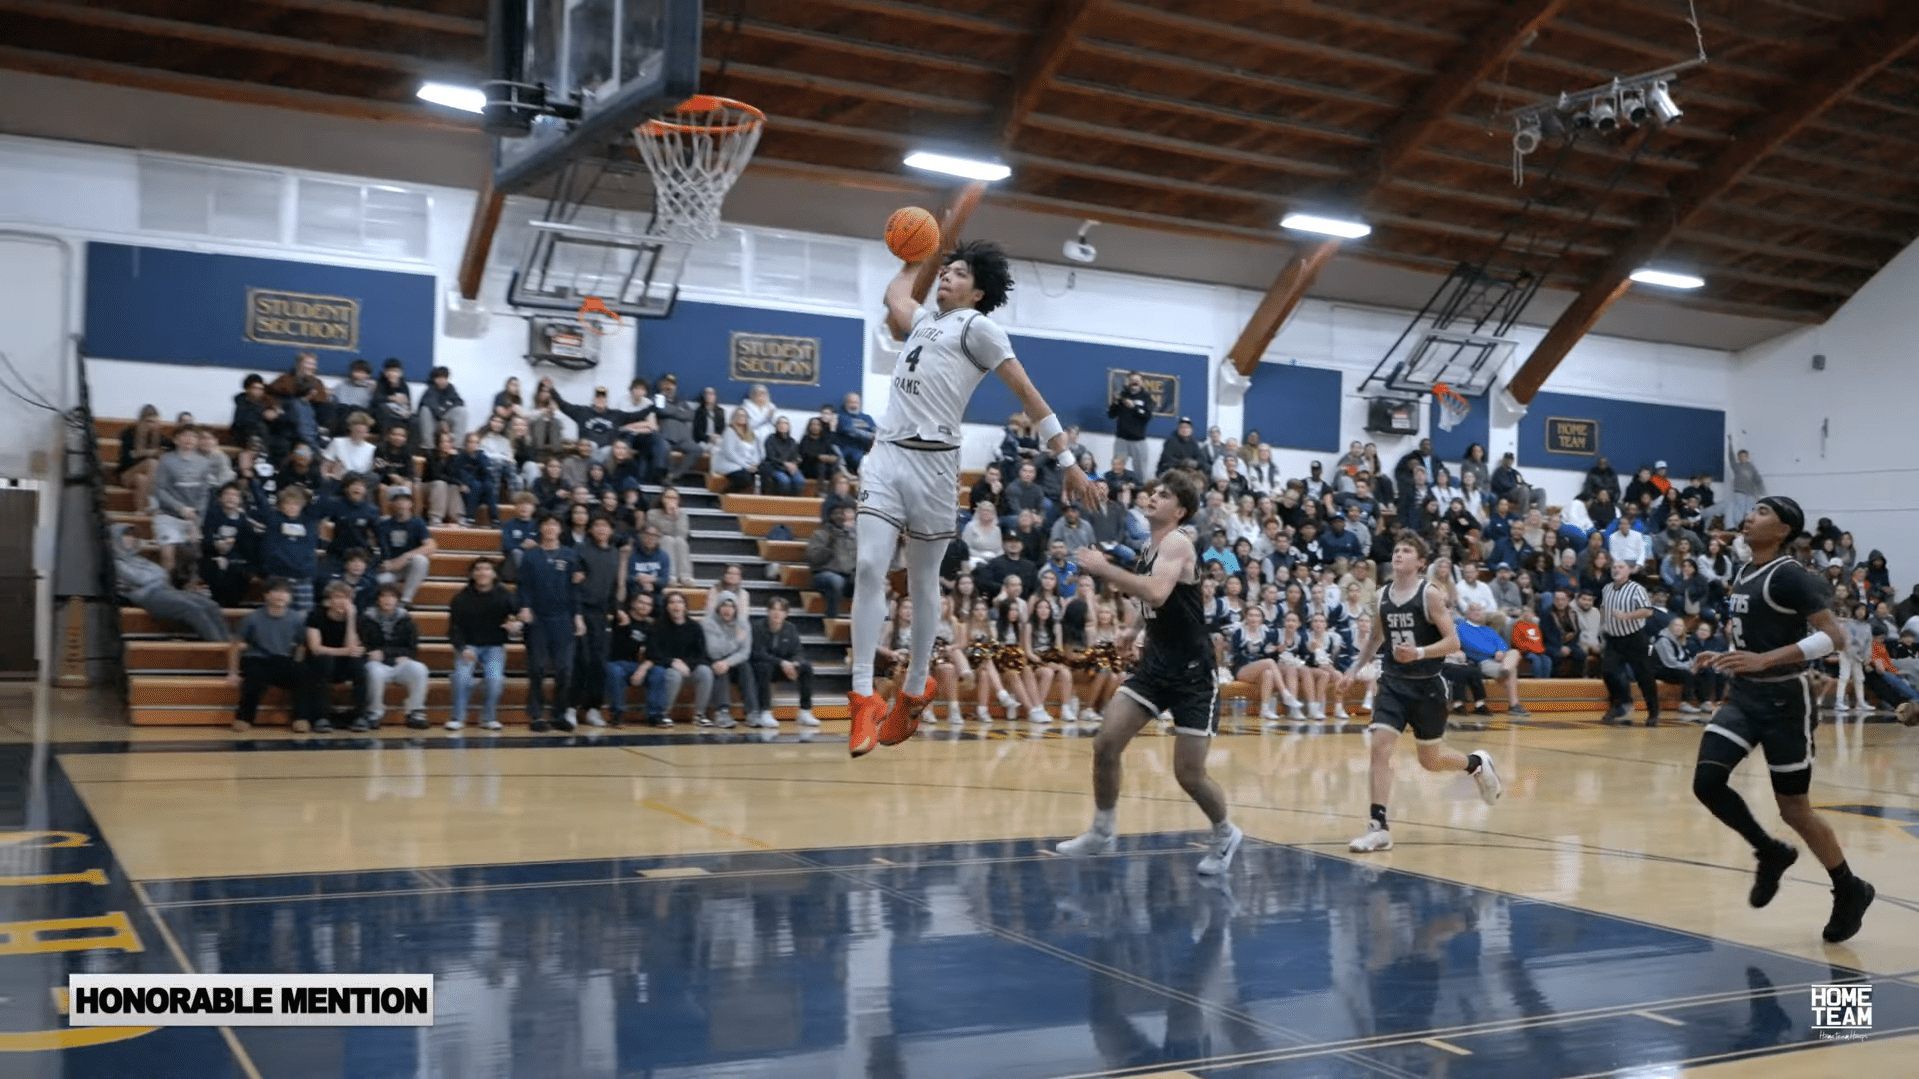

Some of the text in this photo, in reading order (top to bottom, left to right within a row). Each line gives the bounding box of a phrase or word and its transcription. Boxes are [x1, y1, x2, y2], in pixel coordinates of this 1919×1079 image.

[256, 298, 351, 323] STUDENT
[256, 316, 349, 340] SECTION
[739, 341, 813, 360] STUDENT
[905, 345, 923, 372] 4
[739, 357, 811, 376] SECTION
[1557, 423, 1588, 436] HOME
[1559, 435, 1587, 449] TEAM
[1386, 612, 1415, 628] SFHS
